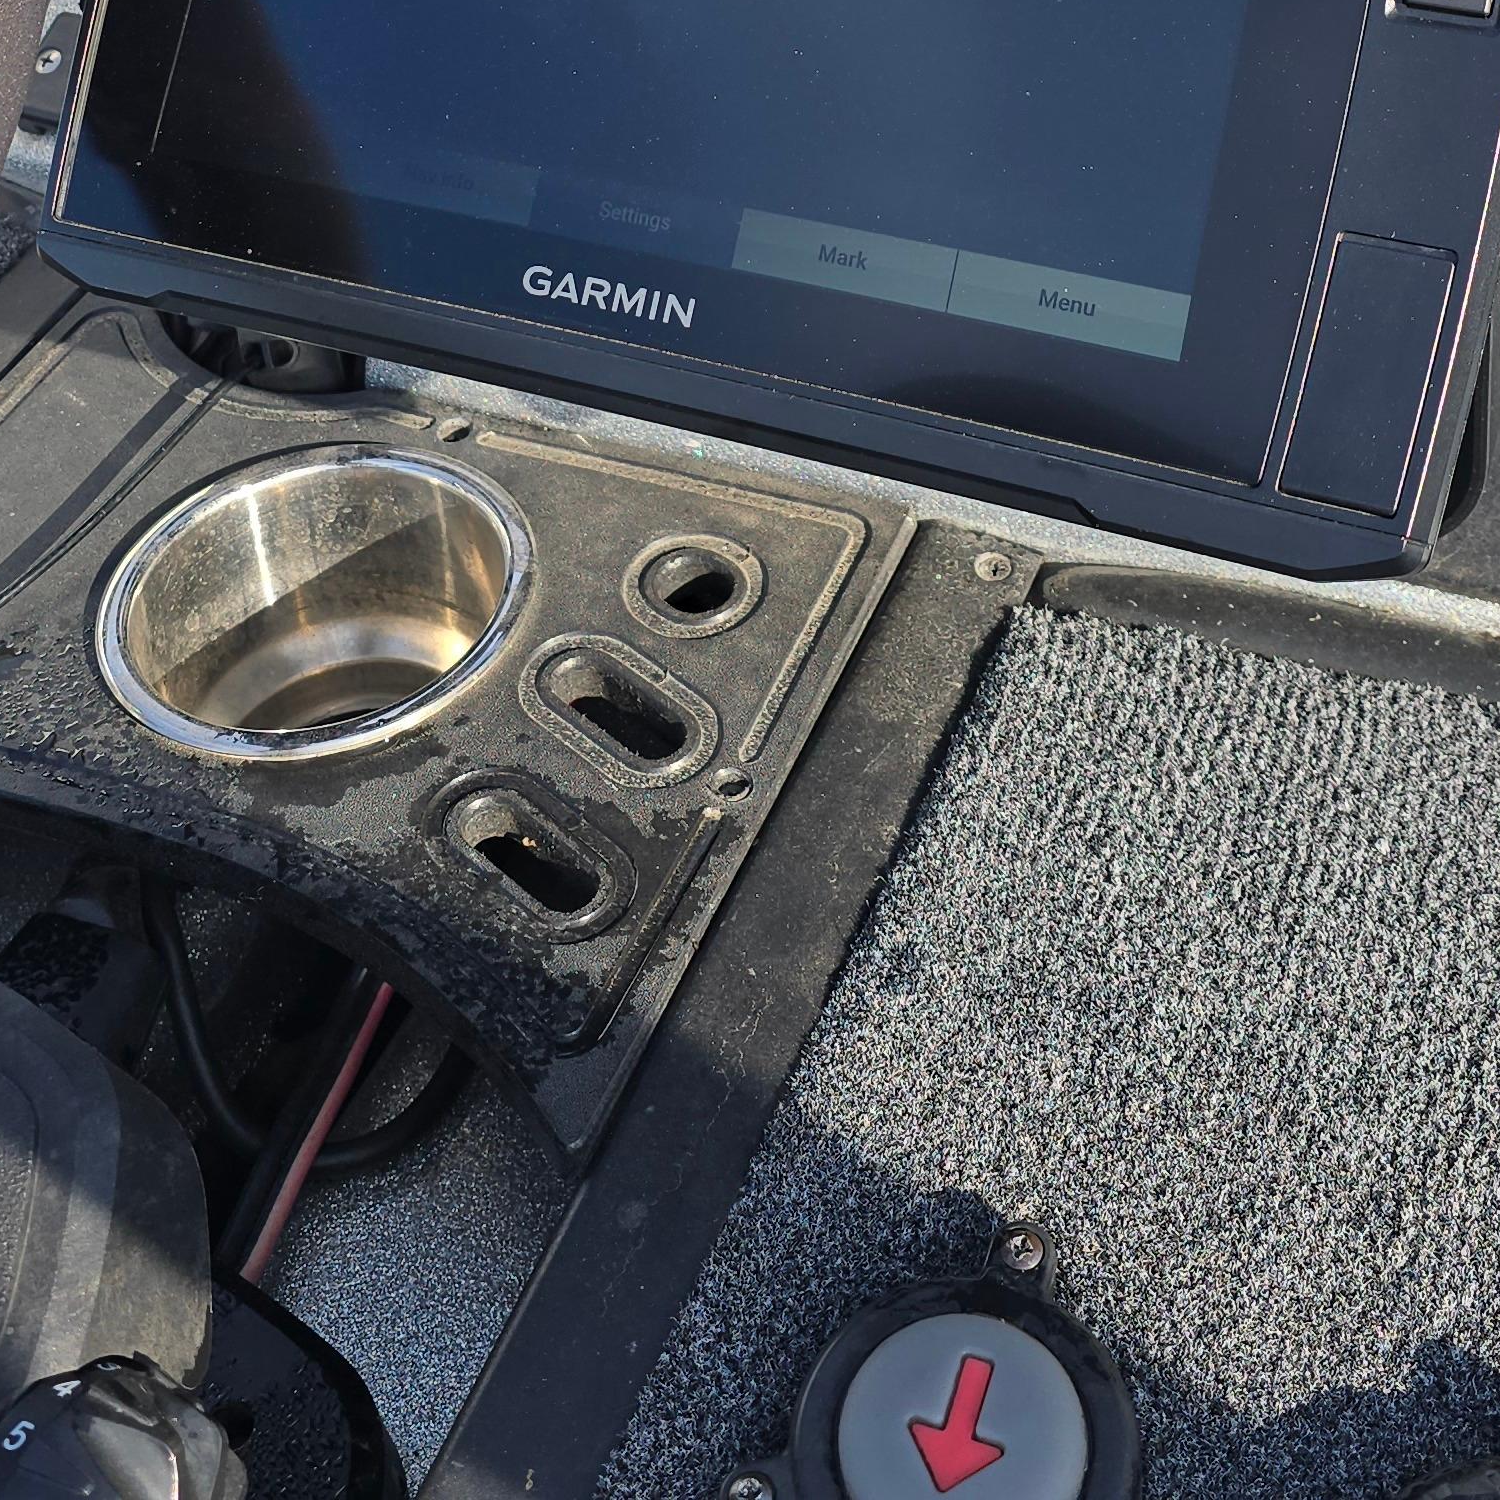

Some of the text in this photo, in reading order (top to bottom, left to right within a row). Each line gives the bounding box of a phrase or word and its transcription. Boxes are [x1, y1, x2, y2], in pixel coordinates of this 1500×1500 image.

[599, 201, 671, 232] Settings
[817, 243, 868, 271] Mark
[522, 265, 696, 328] GARMIN
[1038, 288, 1097, 317] Menu
[52, 1379, 82, 1398] 4
[3, 1420, 35, 1451] 5
